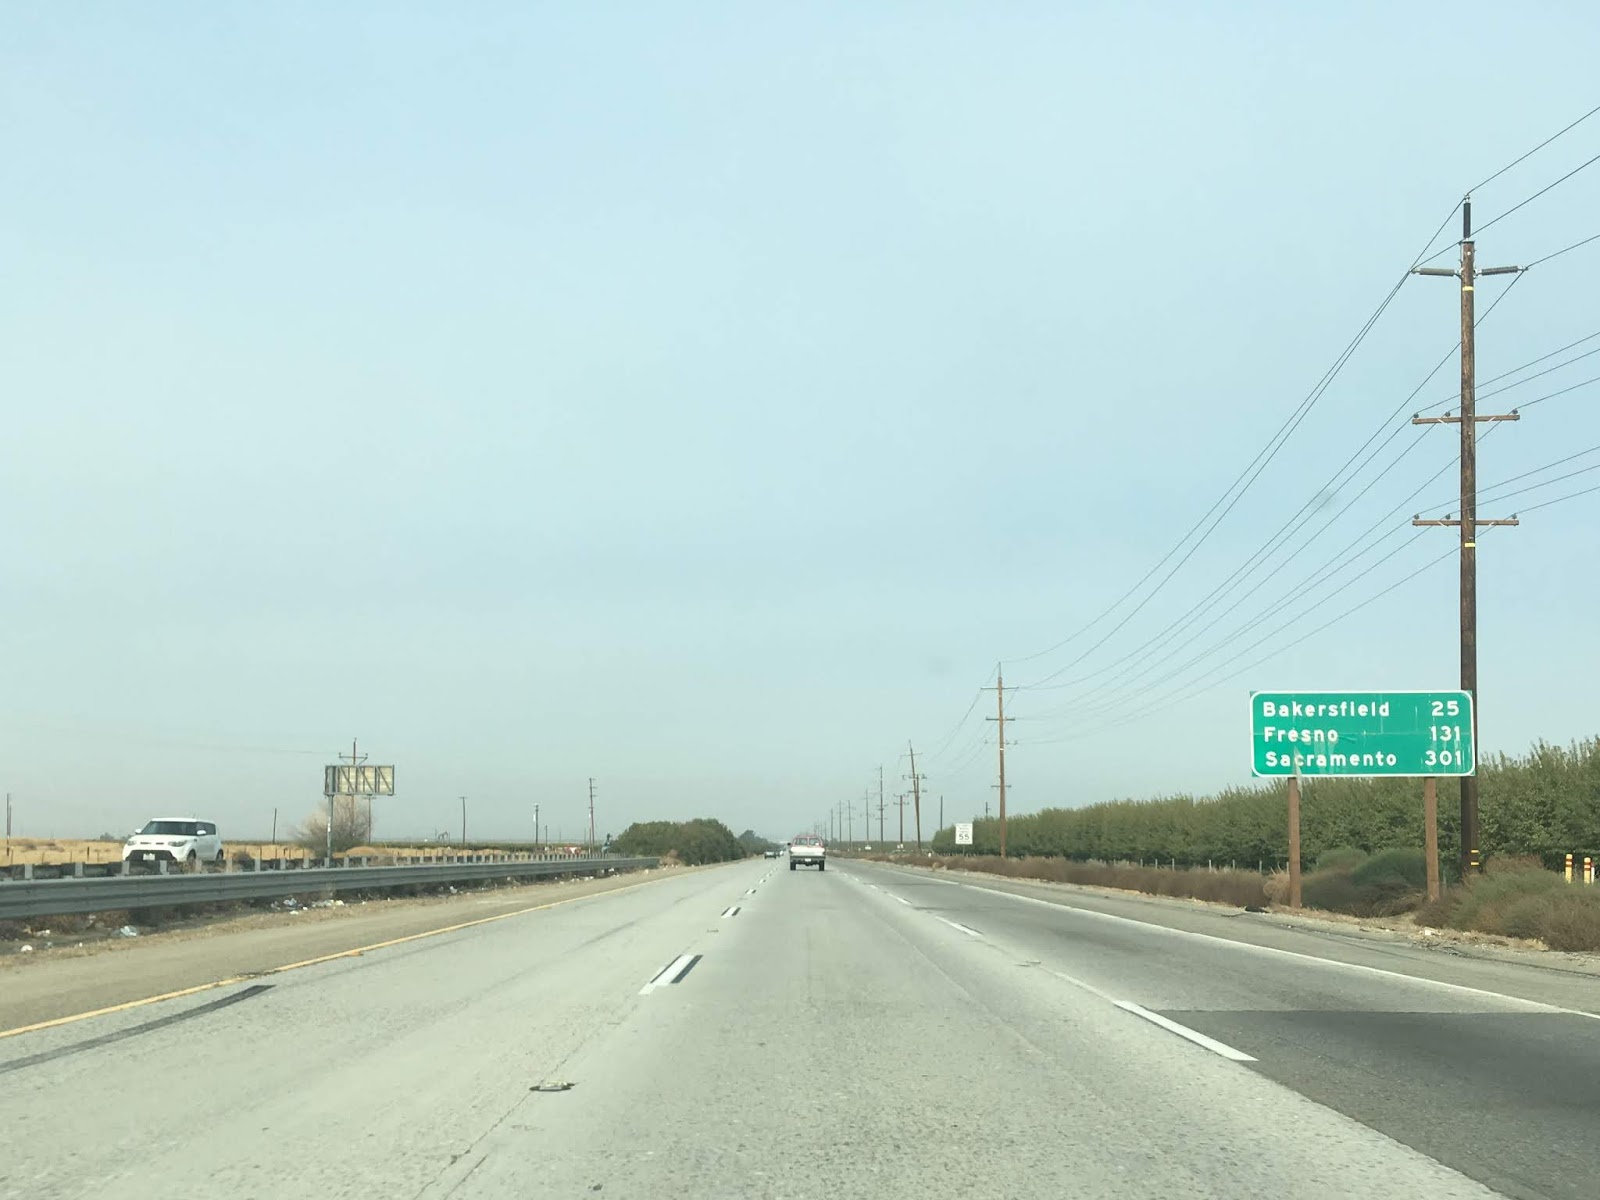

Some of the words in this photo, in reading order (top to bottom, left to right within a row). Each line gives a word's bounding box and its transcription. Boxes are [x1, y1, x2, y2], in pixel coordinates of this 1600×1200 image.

[1263, 701, 1390, 717] Bakersfield
[1431, 700, 1460, 717] 25
[1263, 726, 1339, 743] Fresno
[1429, 725, 1461, 742] 131
[1265, 750, 1397, 767] Sacramento
[1424, 750, 1462, 766] 301
[958, 833, 970, 841] 55
